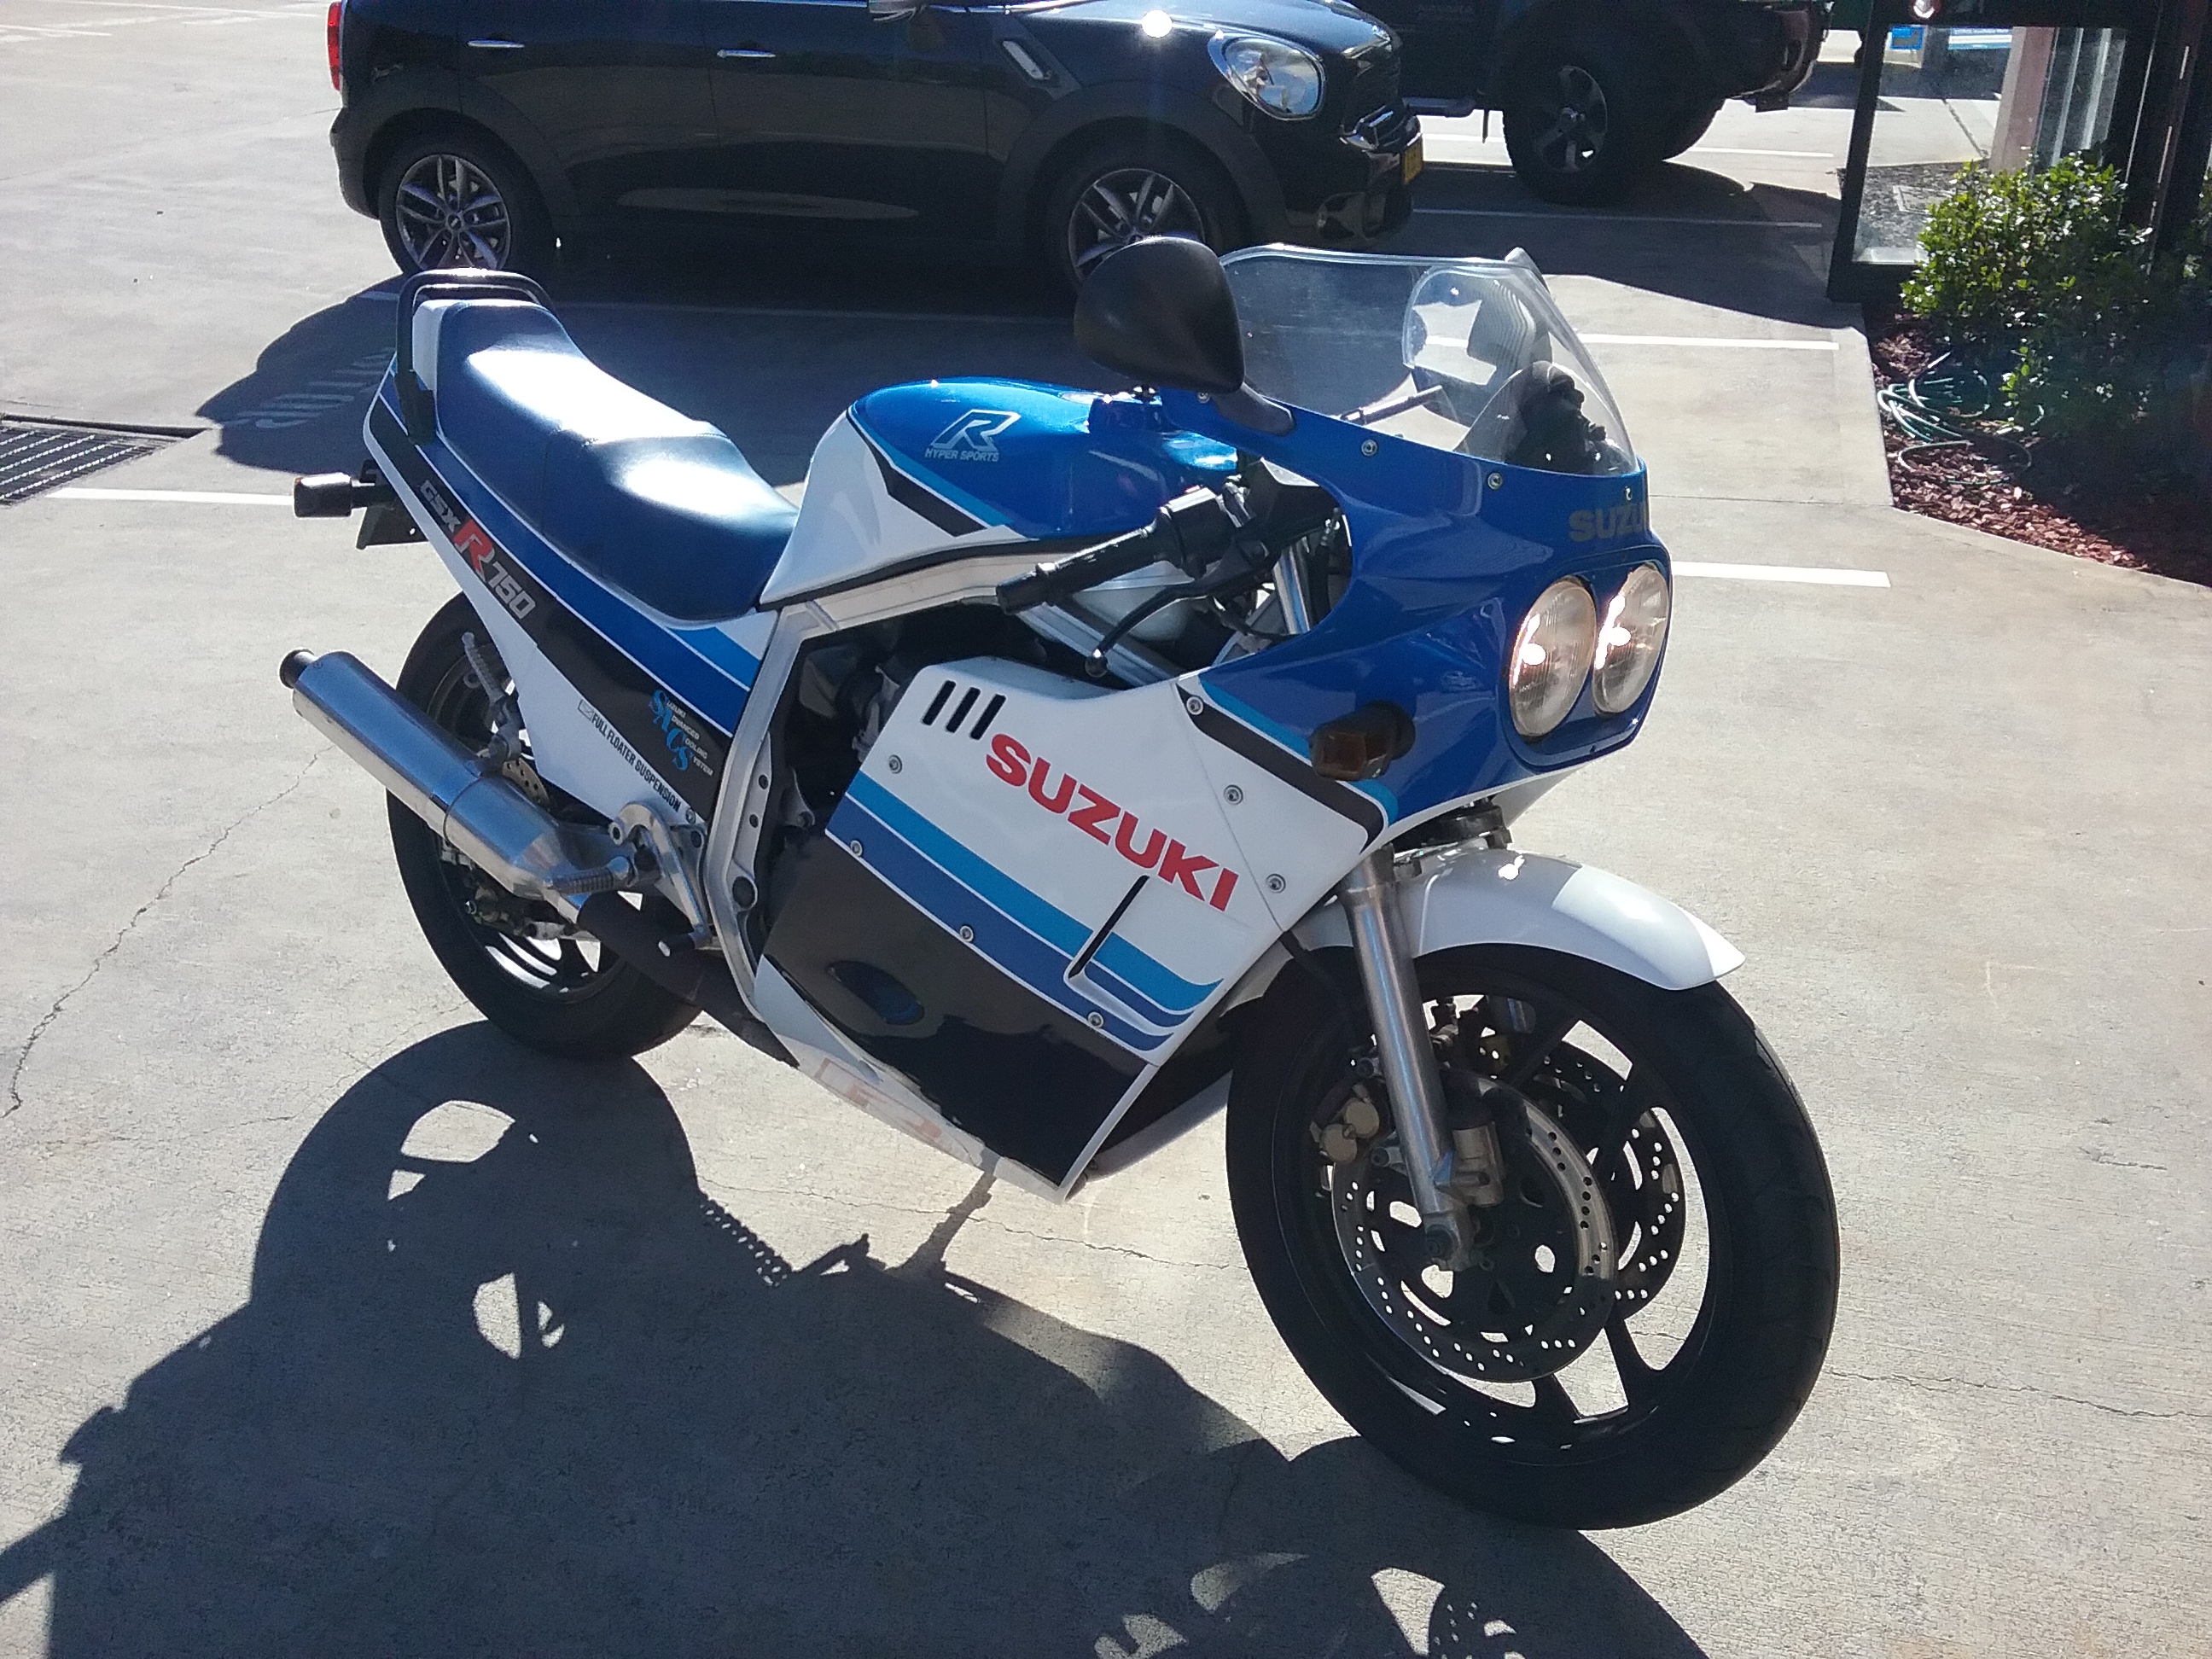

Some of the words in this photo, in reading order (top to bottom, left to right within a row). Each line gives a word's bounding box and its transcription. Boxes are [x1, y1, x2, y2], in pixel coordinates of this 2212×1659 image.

[924, 447, 958, 460] HYPER
[959, 450, 1000, 463] SPORTS
[591, 713, 608, 736] FULL
[607, 729, 636, 765] FLOATER
[635, 760, 682, 812] SUSPENSION
[986, 733, 1239, 912] SUZUKI
